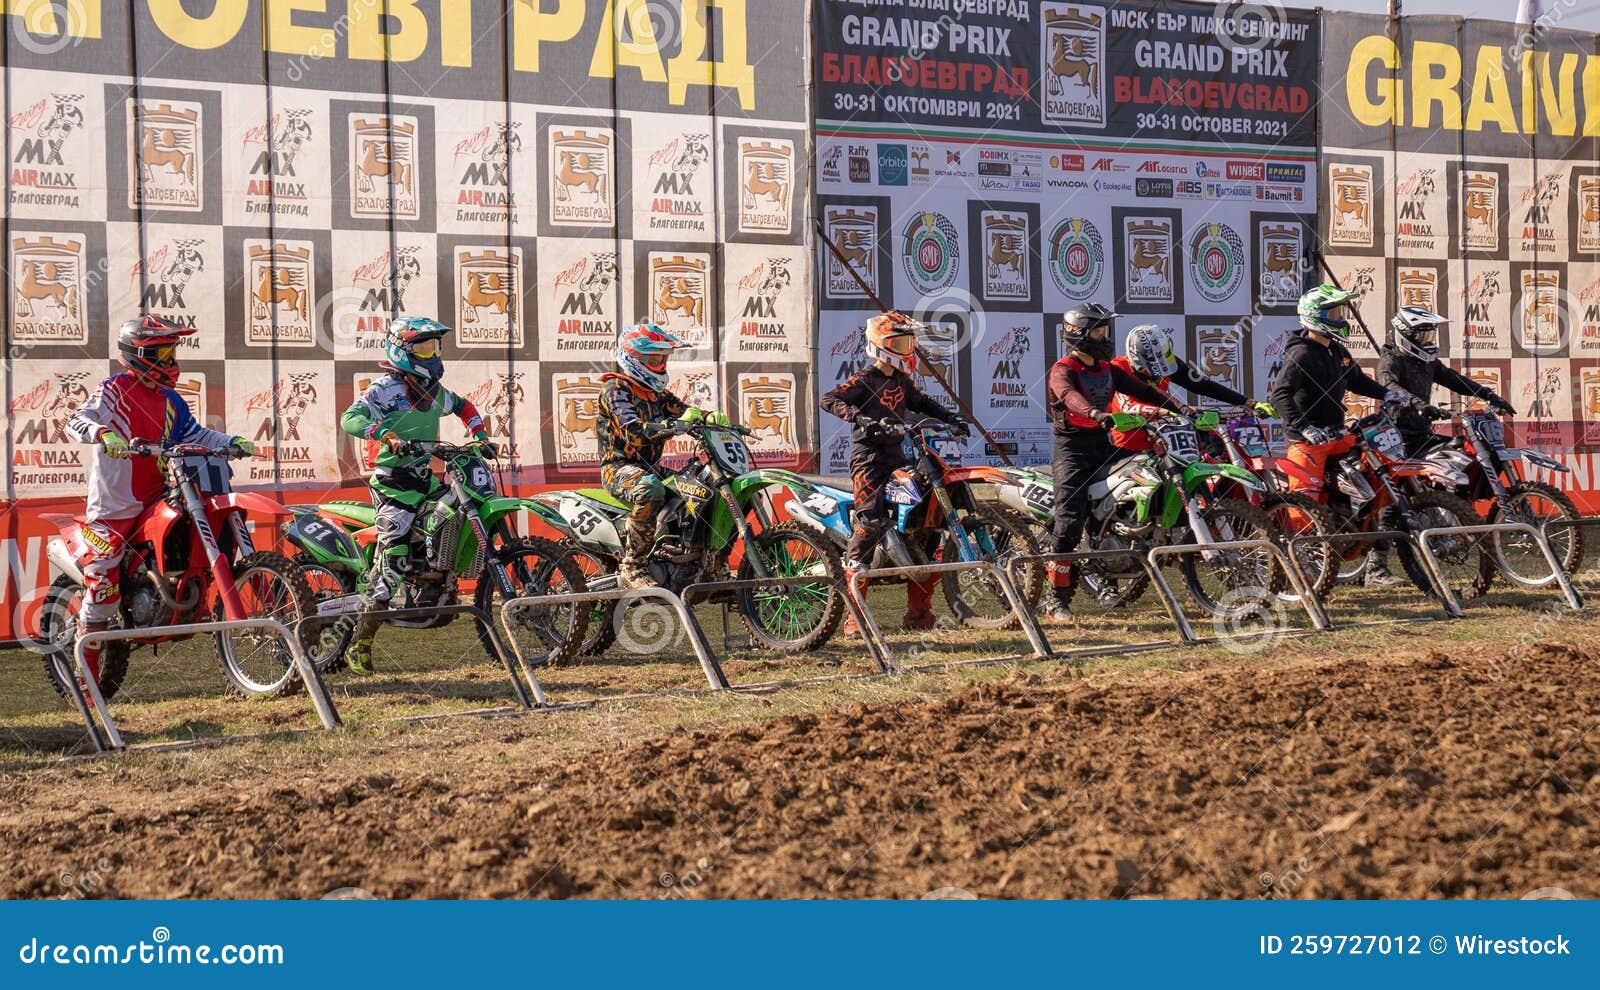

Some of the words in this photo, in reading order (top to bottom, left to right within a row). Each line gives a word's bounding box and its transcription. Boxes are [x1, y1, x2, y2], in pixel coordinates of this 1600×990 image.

[1112, 10, 1149, 29] МСК
[1157, 13, 1187, 32] ЕЪР
[1192, 16, 1236, 36] МАКС
[1240, 18, 1309, 41] РЕЙСИНГ
[842, 15, 940, 50] GRAND
[949, 23, 1012, 57] PRIX
[1135, 40, 1224, 72] GRAND
[1232, 47, 1289, 77] PRIX
[823, 53, 1031, 101] БЛАГОЕВГРАД
[1114, 76, 1309, 113] BLAGOEVGRAD
[834, 93, 876, 111] 30-31
[884, 95, 981, 118] ОКТОМВРИ
[986, 102, 1020, 120] 2021
[1047, 100, 1101, 119] БЛАГОЕВГРАД
[1136, 113, 1176, 130] 30-31
[1182, 115, 1252, 134] OCTOBER
[1255, 121, 1288, 136] 2021
[14, 138, 64, 165] MX
[848, 145, 869, 157] Raffy
[249, 151, 296, 176] MX
[879, 157, 907, 168] Orbita
[1230, 165, 1262, 177] WINBET
[12, 169, 76, 187] AIRMAX
[460, 162, 508, 186] MX
[653, 172, 693, 195] MX
[1048, 180, 1088, 188] VIVACOM
[136, 188, 198, 203] БЛАГОЕВГРАД
[457, 191, 515, 206] AIRMAX
[1264, 191, 1292, 201] Baumit
[555, 206, 611, 220] БЛАГОЕВГРАД
[651, 198, 702, 214] AIRMAX
[1400, 201, 1426, 220] MX
[1524, 206, 1550, 224] MX
[743, 213, 788, 227] БЛАГОЕВГРАД
[1398, 222, 1433, 236] AIRMAX
[1522, 227, 1555, 239] AIRMAX
[138, 283, 186, 308] MX
[359, 288, 406, 312] MX
[560, 292, 603, 315] MX
[742, 296, 776, 318] MX
[1465, 303, 1489, 321] MX
[15, 322, 82, 337] БЛАГОЕВГРАД
[558, 320, 612, 335] AIRMAX
[740, 321, 786, 335] AIRMAX
[1463, 324, 1495, 337] AIRMAX
[992, 361, 1020, 379] MX
[991, 384, 1027, 396] AIRMAX
[1527, 400, 1553, 417] MX
[16, 419, 70, 444] MX
[255, 417, 301, 440] MX
[1527, 421, 1560, 432] AIRMAX
[12, 449, 81, 466] AIRMAX
[723, 442, 746, 464] 55
[570, 510, 602, 535] 55
